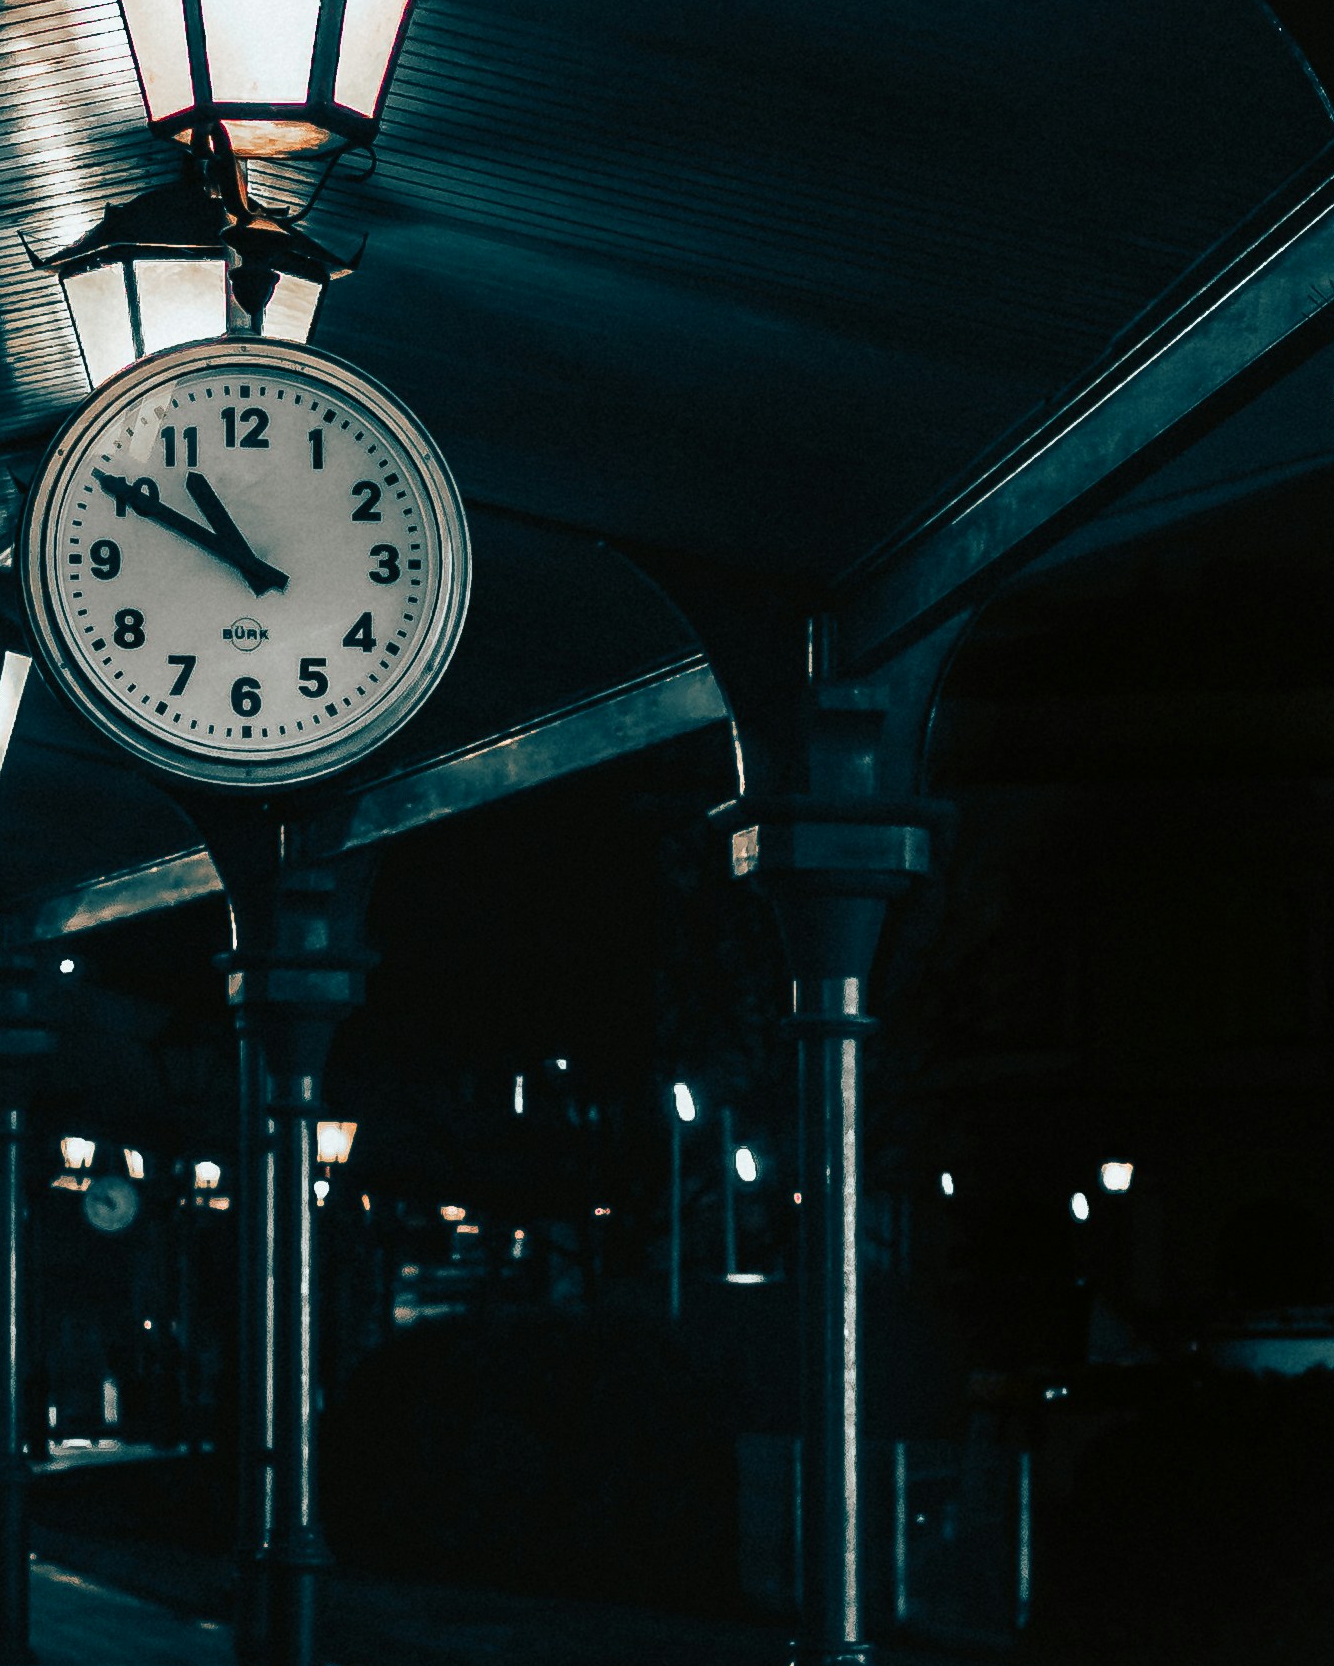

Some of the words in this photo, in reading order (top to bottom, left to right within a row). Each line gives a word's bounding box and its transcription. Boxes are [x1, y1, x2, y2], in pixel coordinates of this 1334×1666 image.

[161, 426, 197, 467] 11
[221, 407, 269, 448] 12
[308, 428, 323, 469] 1
[352, 481, 381, 521] 2
[90, 540, 121, 580] 9
[369, 544, 400, 584] 3
[114, 608, 145, 649] 8
[222, 625, 269, 641] BÜRK
[343, 612, 377, 652] 4
[168, 655, 196, 696] 7
[299, 658, 328, 698] 5
[231, 677, 261, 717] 6
